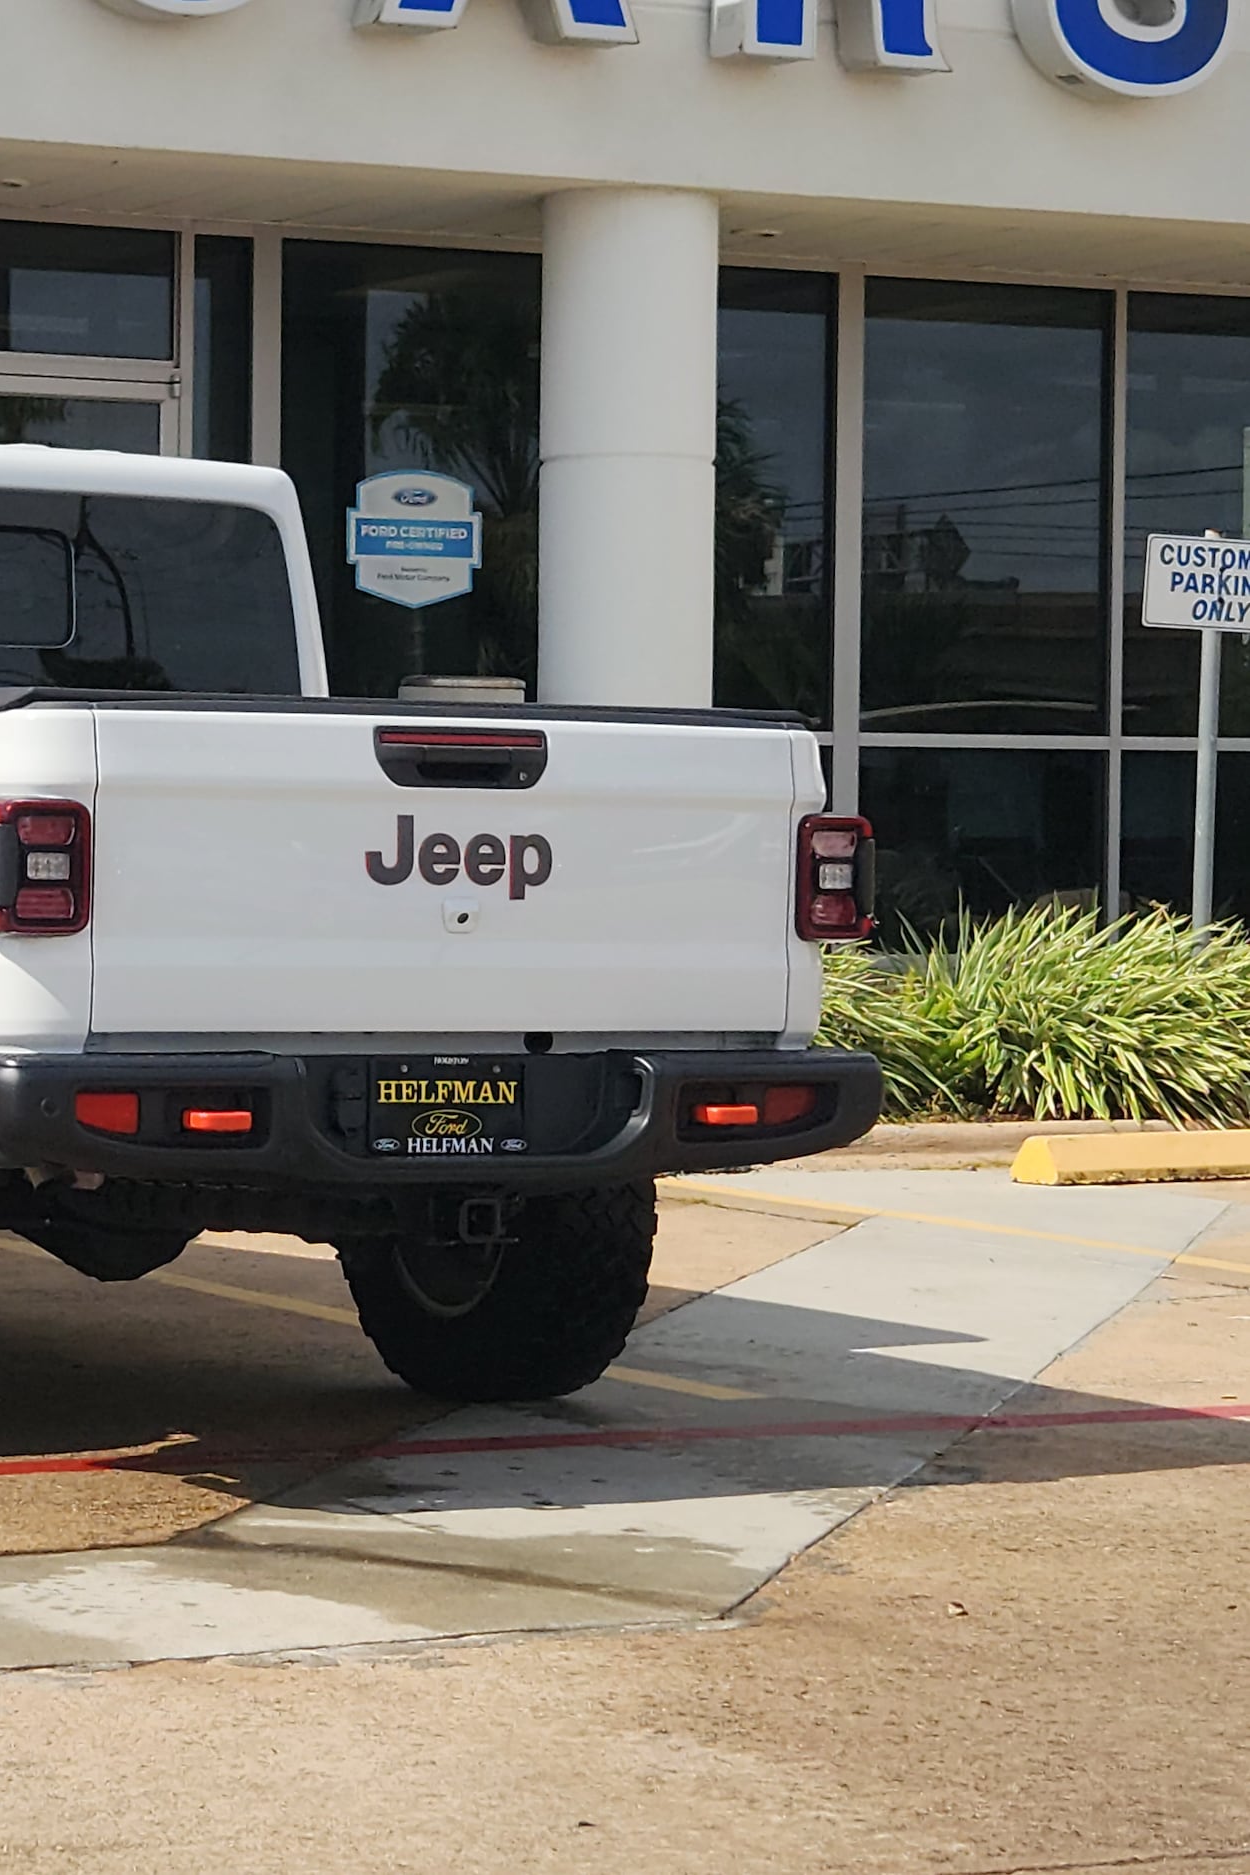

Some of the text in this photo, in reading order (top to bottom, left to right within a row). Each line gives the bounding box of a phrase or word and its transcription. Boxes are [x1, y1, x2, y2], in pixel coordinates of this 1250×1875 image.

[361, 525, 468, 540] FORD CERTIFIED
[1192, 599, 1250, 623] ONLY
[365, 814, 553, 900] Jeep
[377, 1080, 518, 1104] HELFMAN
[424, 1112, 469, 1136] Ford
[407, 1137, 494, 1154] HELFMAN
